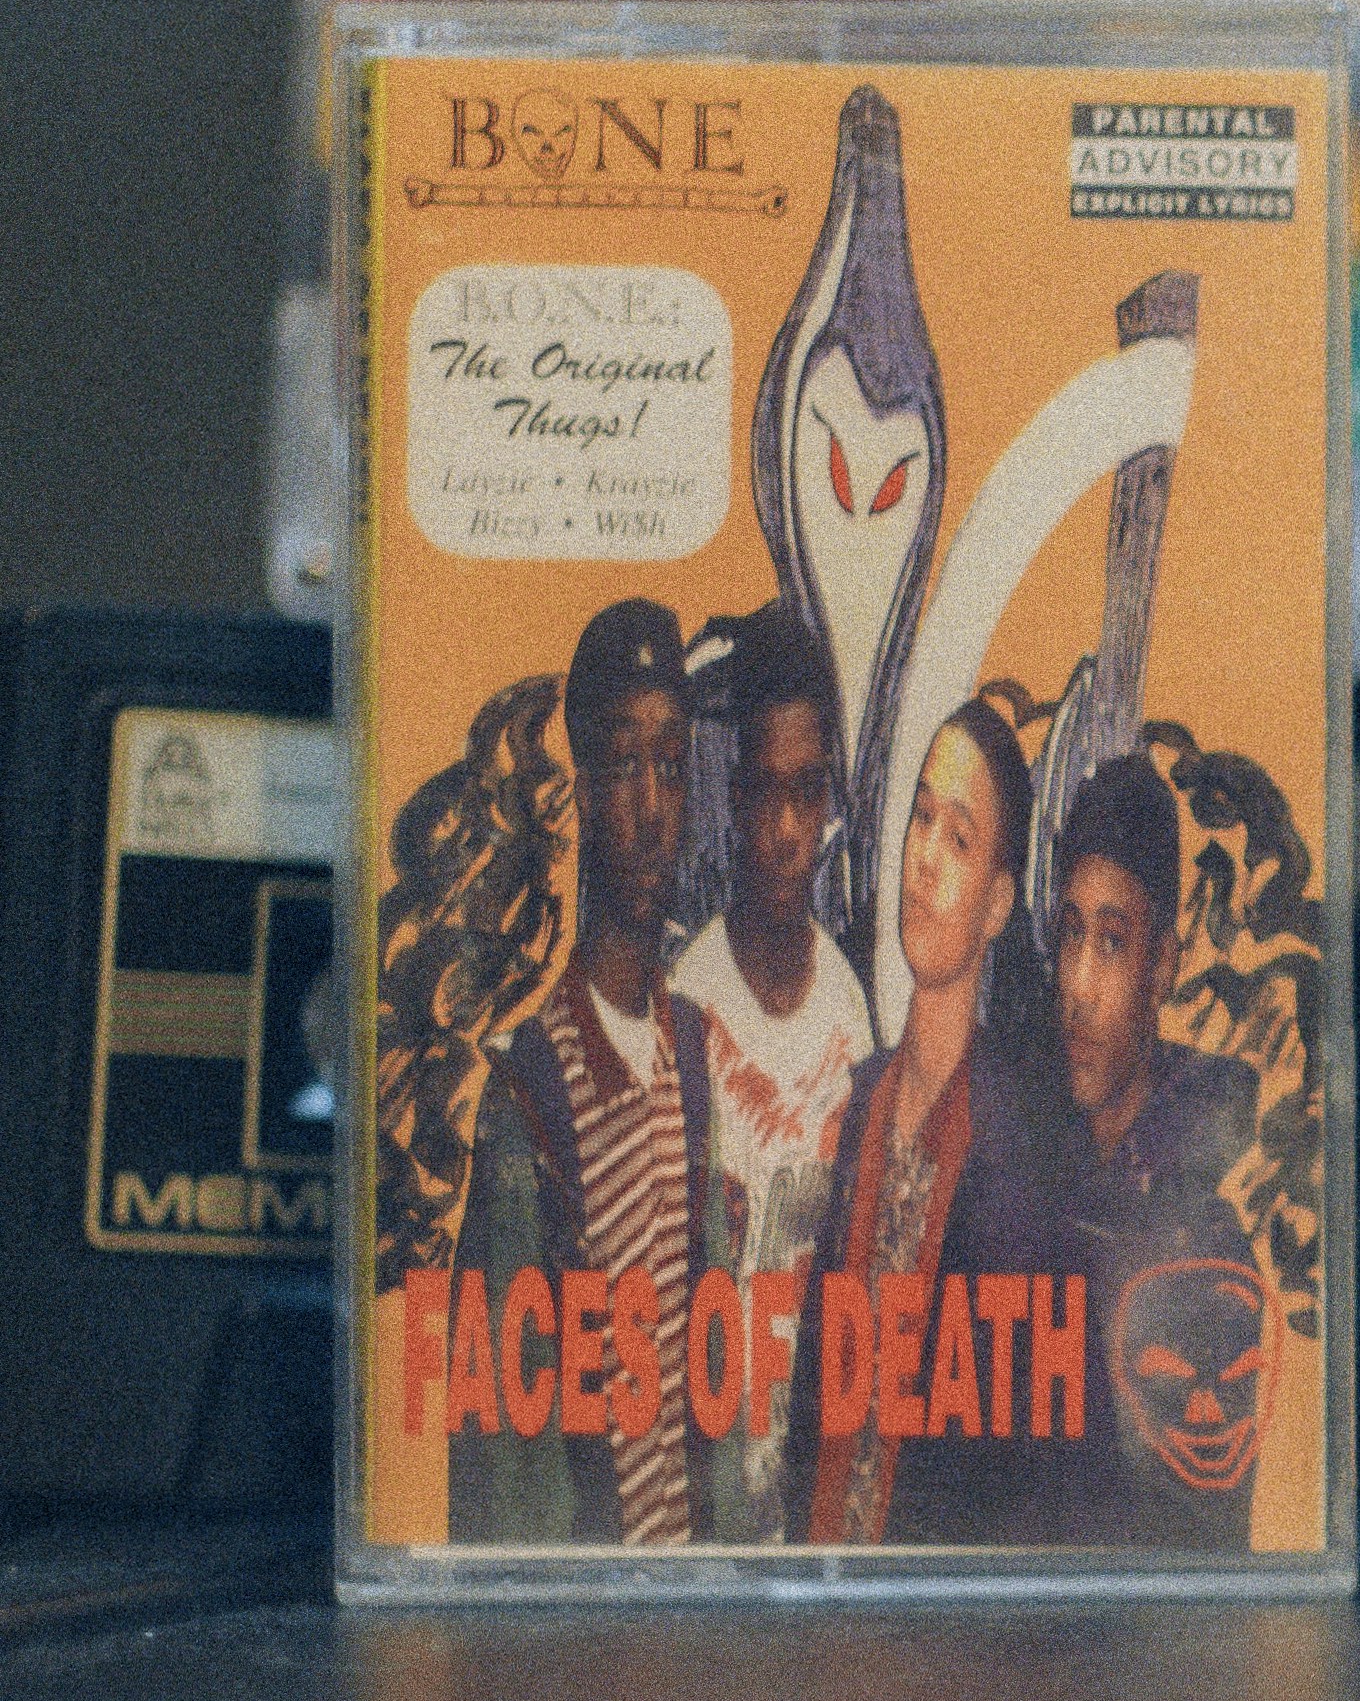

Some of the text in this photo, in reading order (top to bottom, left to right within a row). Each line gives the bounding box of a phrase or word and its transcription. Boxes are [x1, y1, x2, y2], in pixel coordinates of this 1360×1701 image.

[1091, 106, 1275, 136] PARENTAL
[1076, 147, 1292, 179] ADVISORY
[1071, 191, 1292, 217] EXPLICIT LYRICS
[430, 337, 715, 393] The Original
[493, 397, 651, 448] Thugs!
[112, 1170, 328, 1233] MEM
[402, 1266, 1087, 1439] FACES OF DEATH
